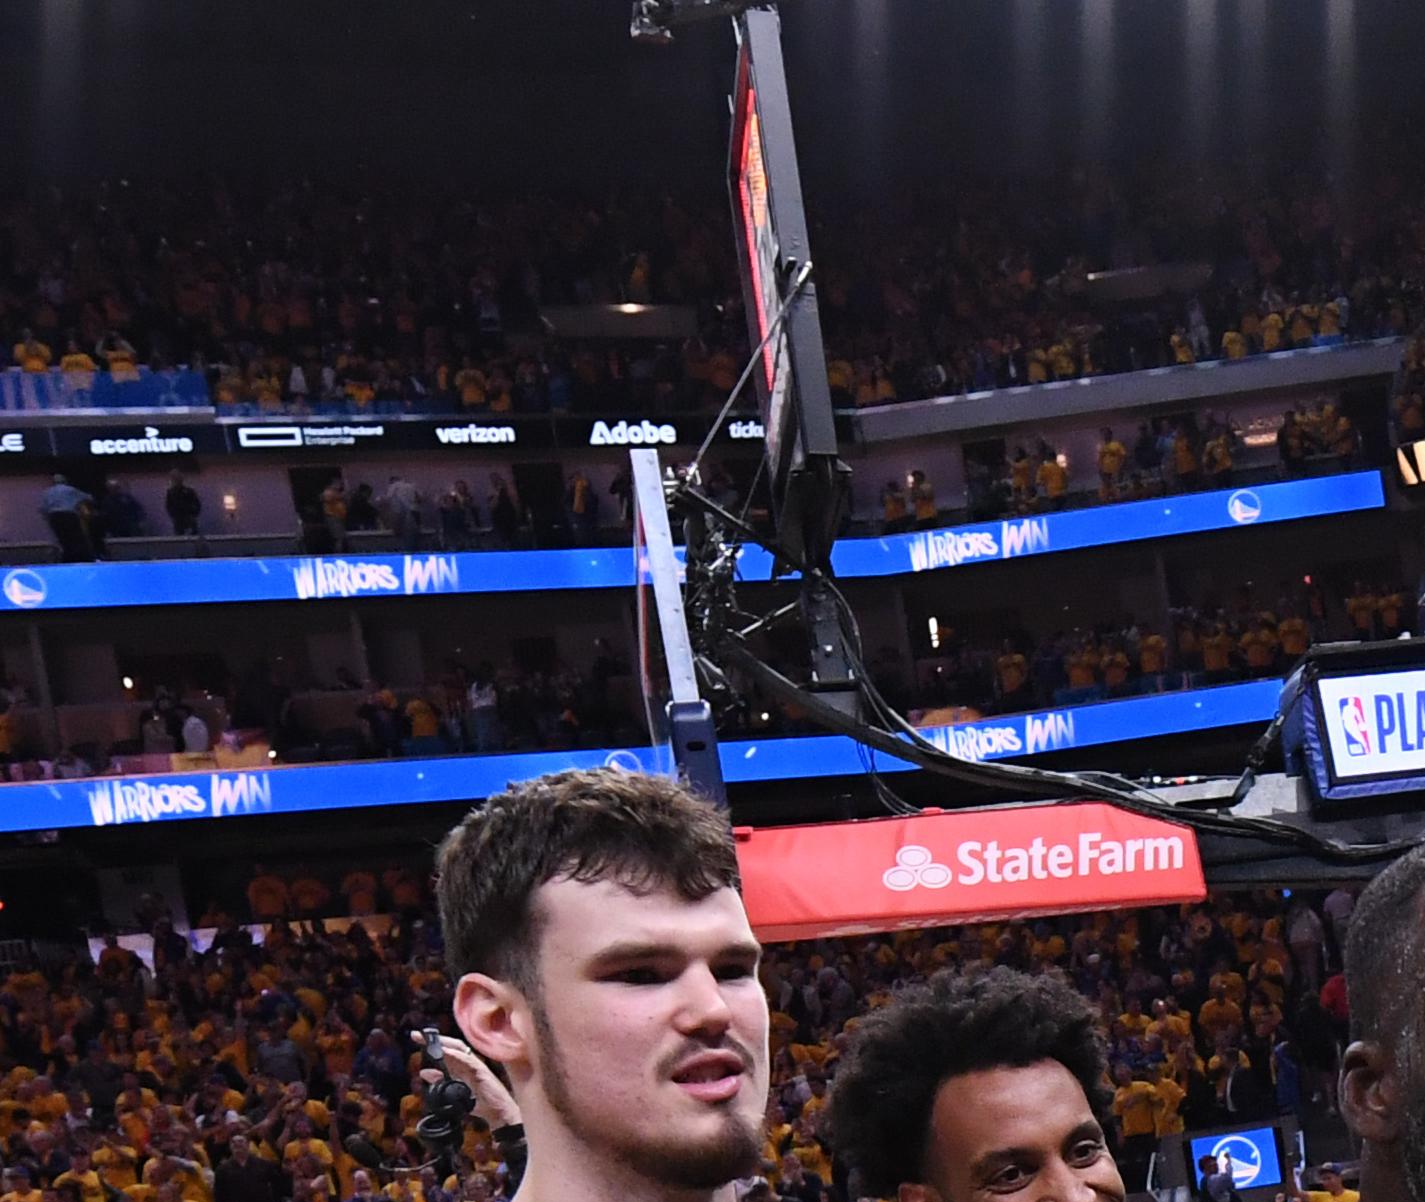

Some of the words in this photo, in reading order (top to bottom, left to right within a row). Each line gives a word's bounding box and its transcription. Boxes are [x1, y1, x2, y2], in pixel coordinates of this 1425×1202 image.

[90, 434, 193, 454] accenture
[435, 423, 516, 444] verizon
[590, 420, 677, 446] Adobe
[909, 530, 999, 572] WARRIORS
[293, 558, 399, 599] WARRIORS
[88, 780, 206, 826] WARRIORS
